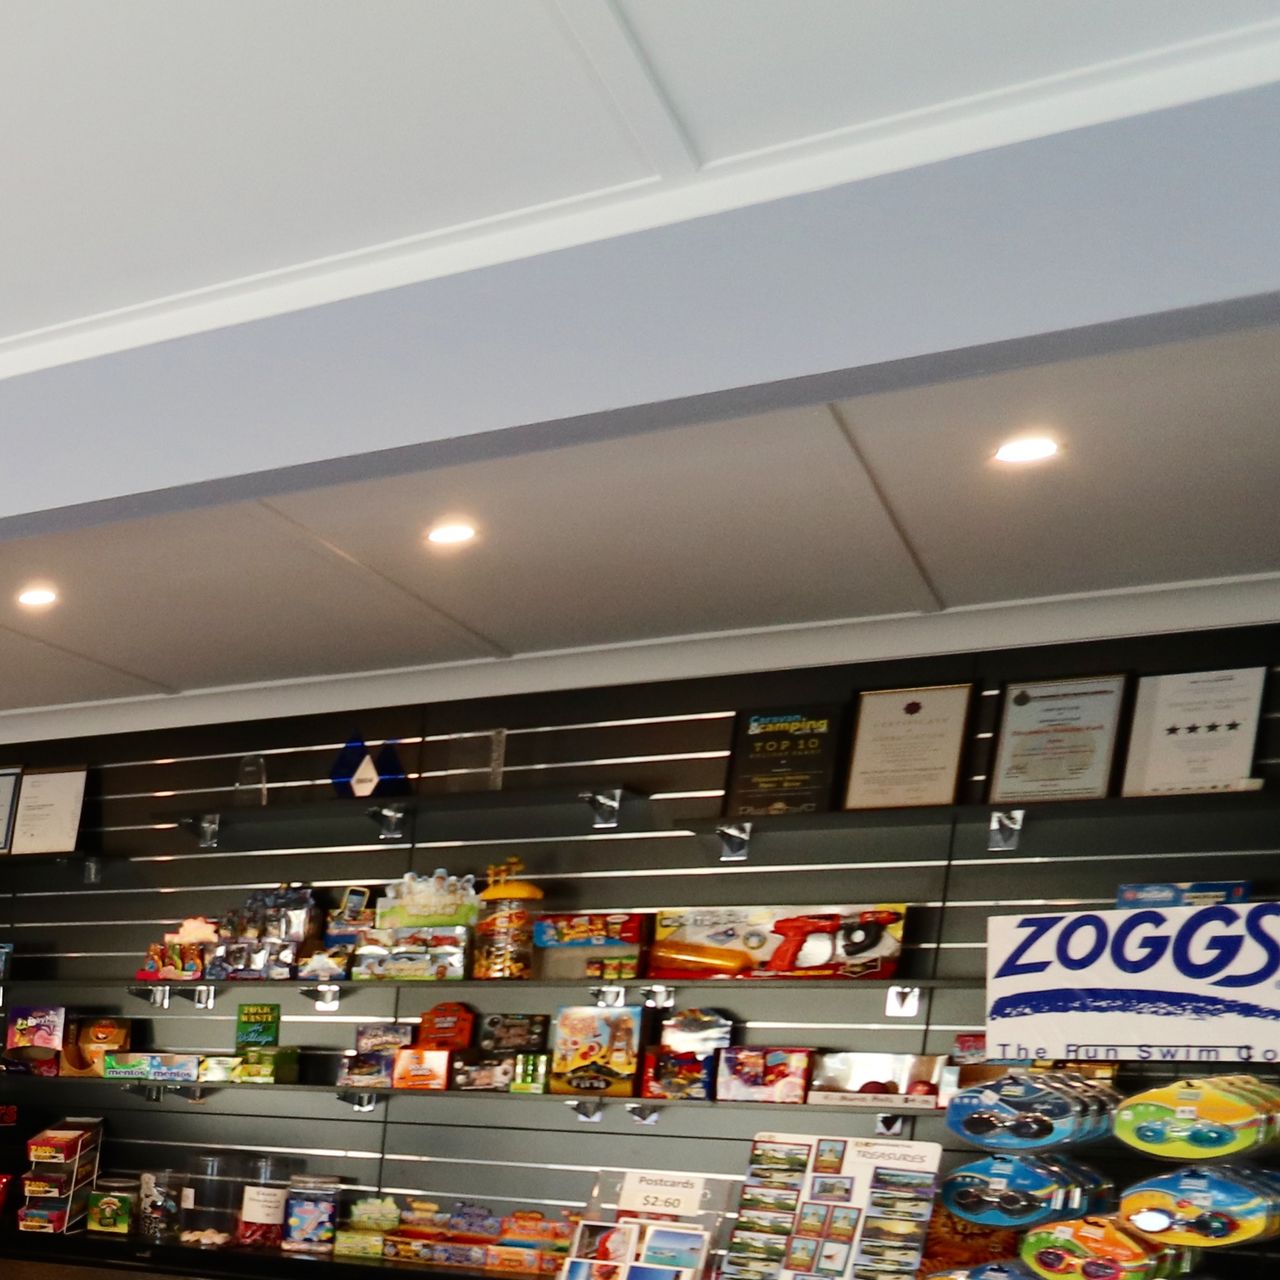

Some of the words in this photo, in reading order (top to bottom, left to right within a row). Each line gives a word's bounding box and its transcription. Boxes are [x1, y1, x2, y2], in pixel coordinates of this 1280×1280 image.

[754, 740, 790, 751] TOP
[797, 739, 819, 749] 10
[993, 902, 1280, 988] ZOGGS
[997, 1044, 1047, 1060] The
[1066, 1044, 1119, 1060] Run
[1139, 1045, 1221, 1060] Swim
[109, 1069, 145, 1077] mentos
[153, 1070, 191, 1078] mentos
[639, 1176, 695, 1189] Postcards
